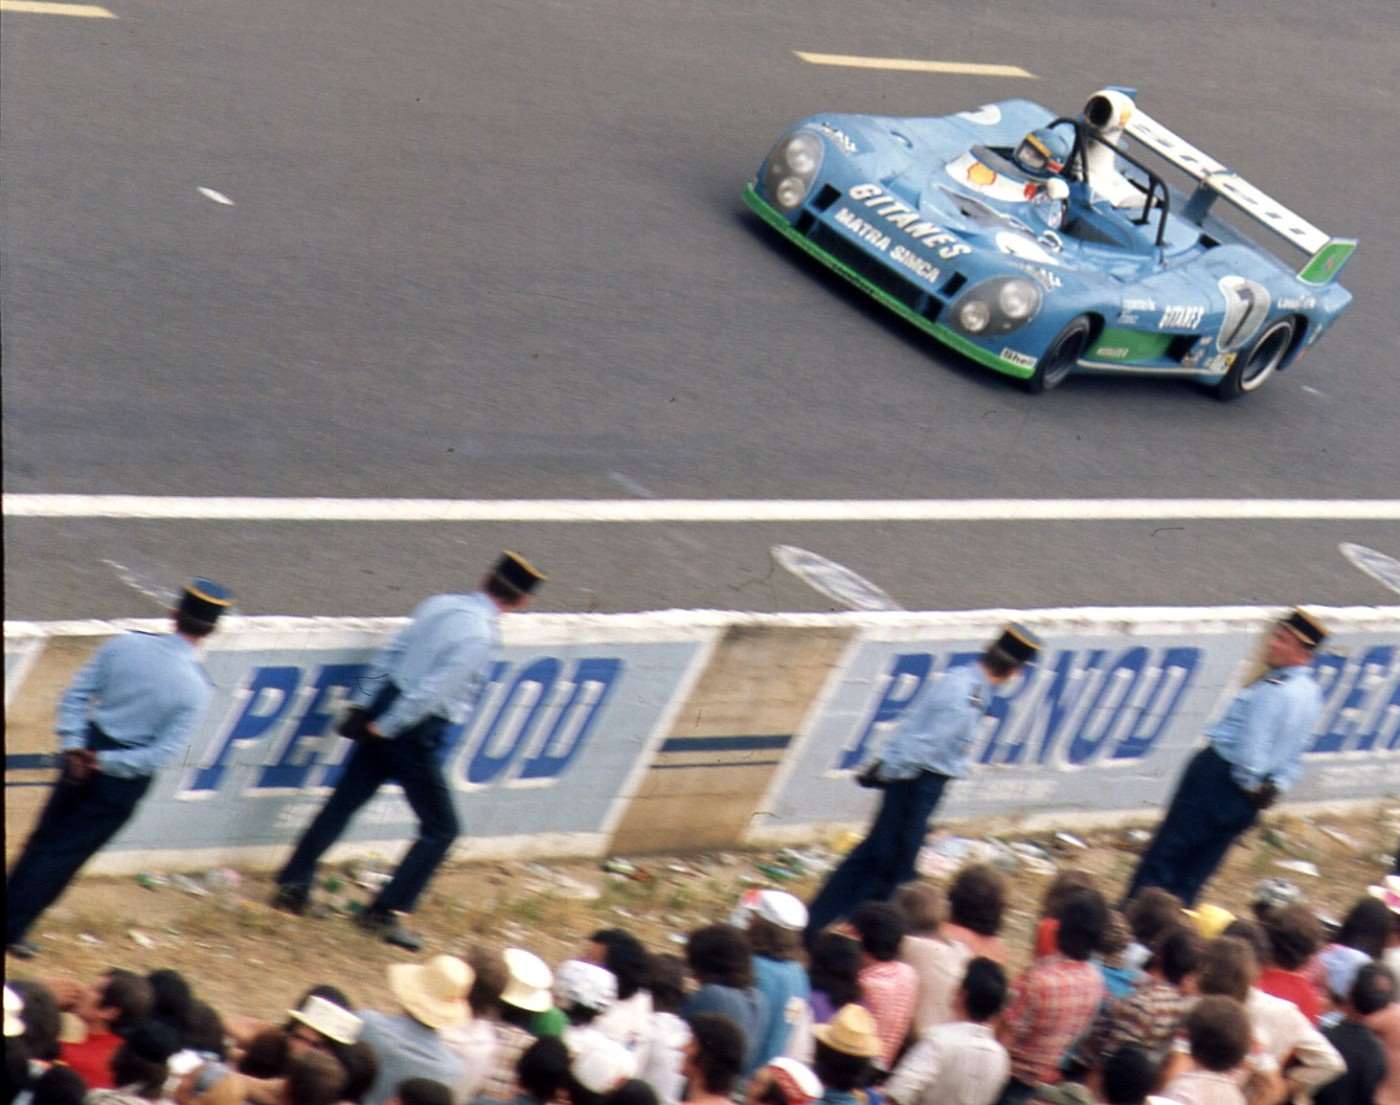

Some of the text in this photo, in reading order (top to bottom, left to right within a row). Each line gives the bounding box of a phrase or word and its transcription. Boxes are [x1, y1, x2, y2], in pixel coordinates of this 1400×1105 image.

[834, 208, 941, 284] MATRA SIMCA
[850, 184, 973, 259] GITANES
[180, 656, 624, 793] PEOD
